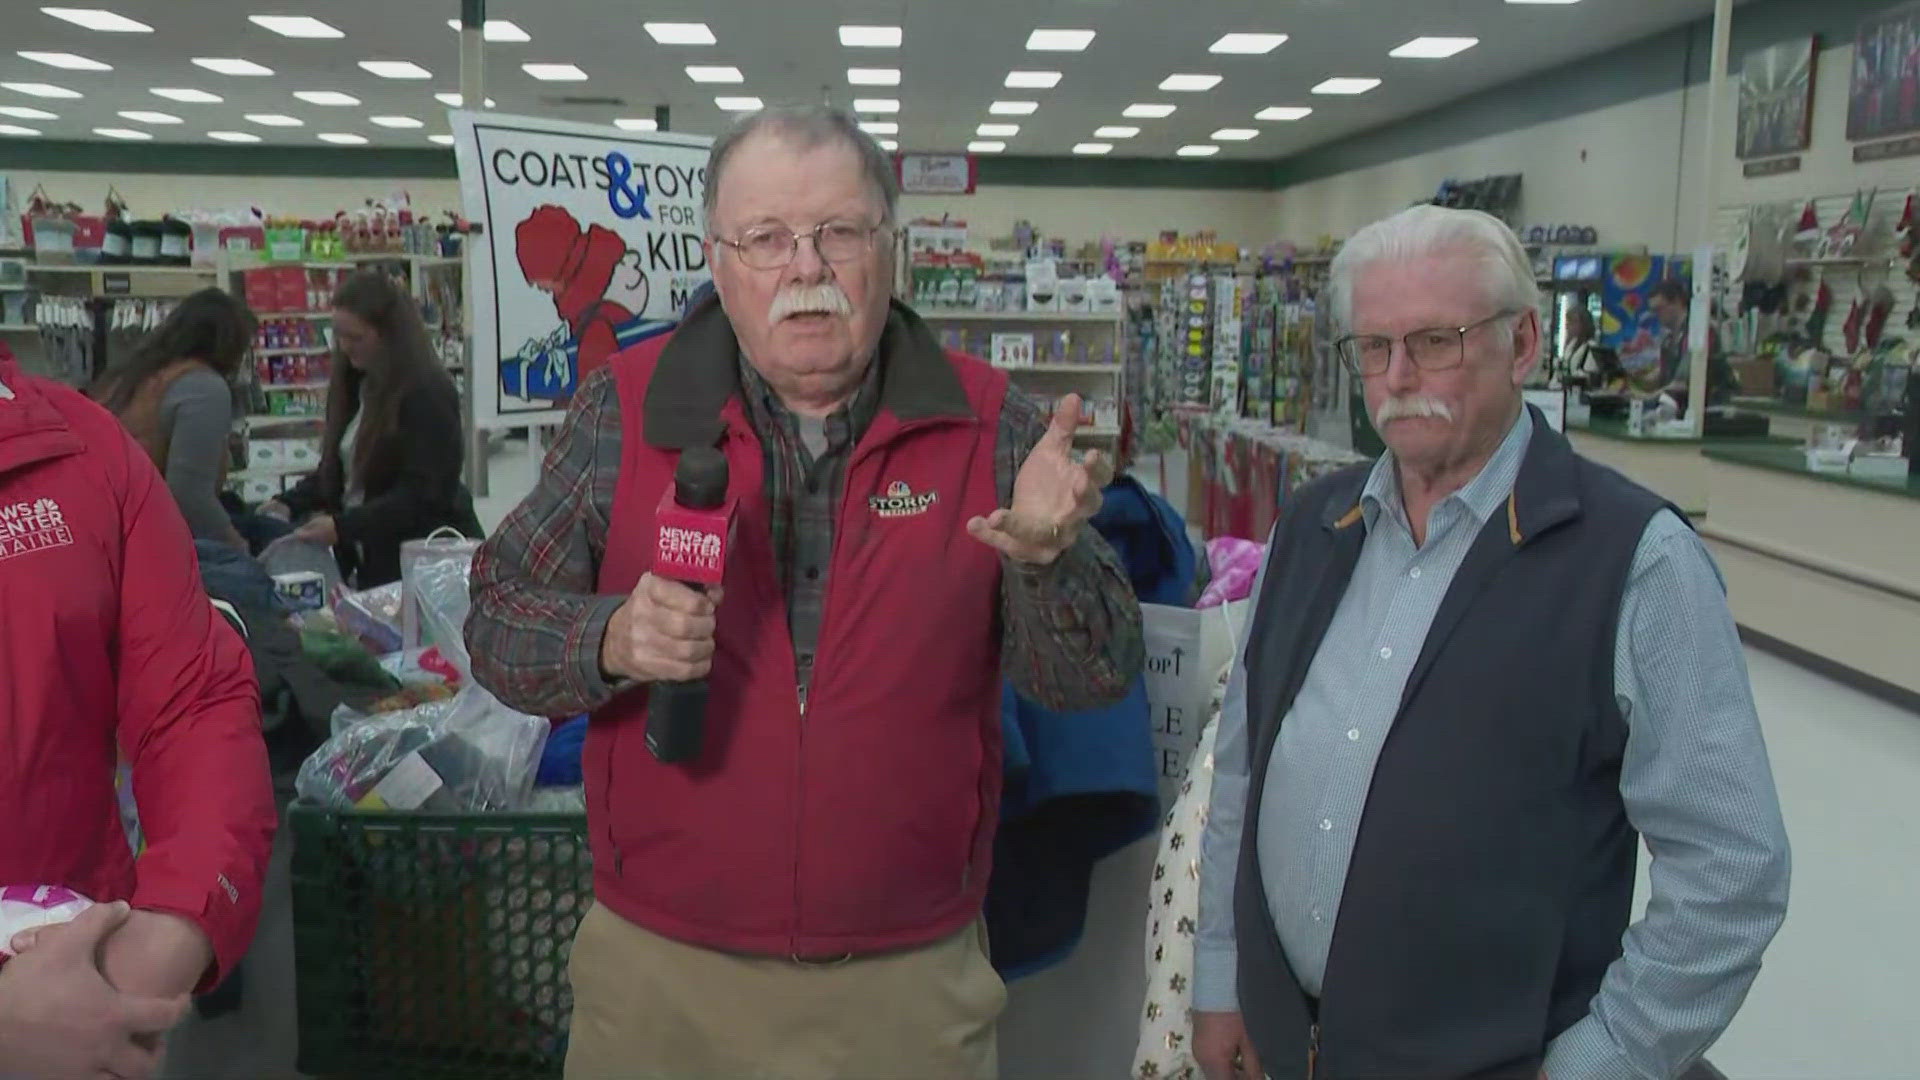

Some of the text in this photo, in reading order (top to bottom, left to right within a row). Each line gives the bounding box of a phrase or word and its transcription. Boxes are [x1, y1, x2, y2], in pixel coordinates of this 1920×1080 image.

[492, 147, 613, 191] COATS
[606, 151, 654, 220] &
[658, 204, 695, 225] FOR
[647, 231, 706, 271] KID
[670, 289, 688, 312] M
[868, 490, 938, 510] STORM
[0, 502, 32, 520] WS
[0, 510, 65, 540] ENTER
[660, 525, 702, 543] NEWS
[659, 537, 721, 557] CENTER
[661, 551, 716, 569] MAINE
[1148, 656, 1172, 674] OP
